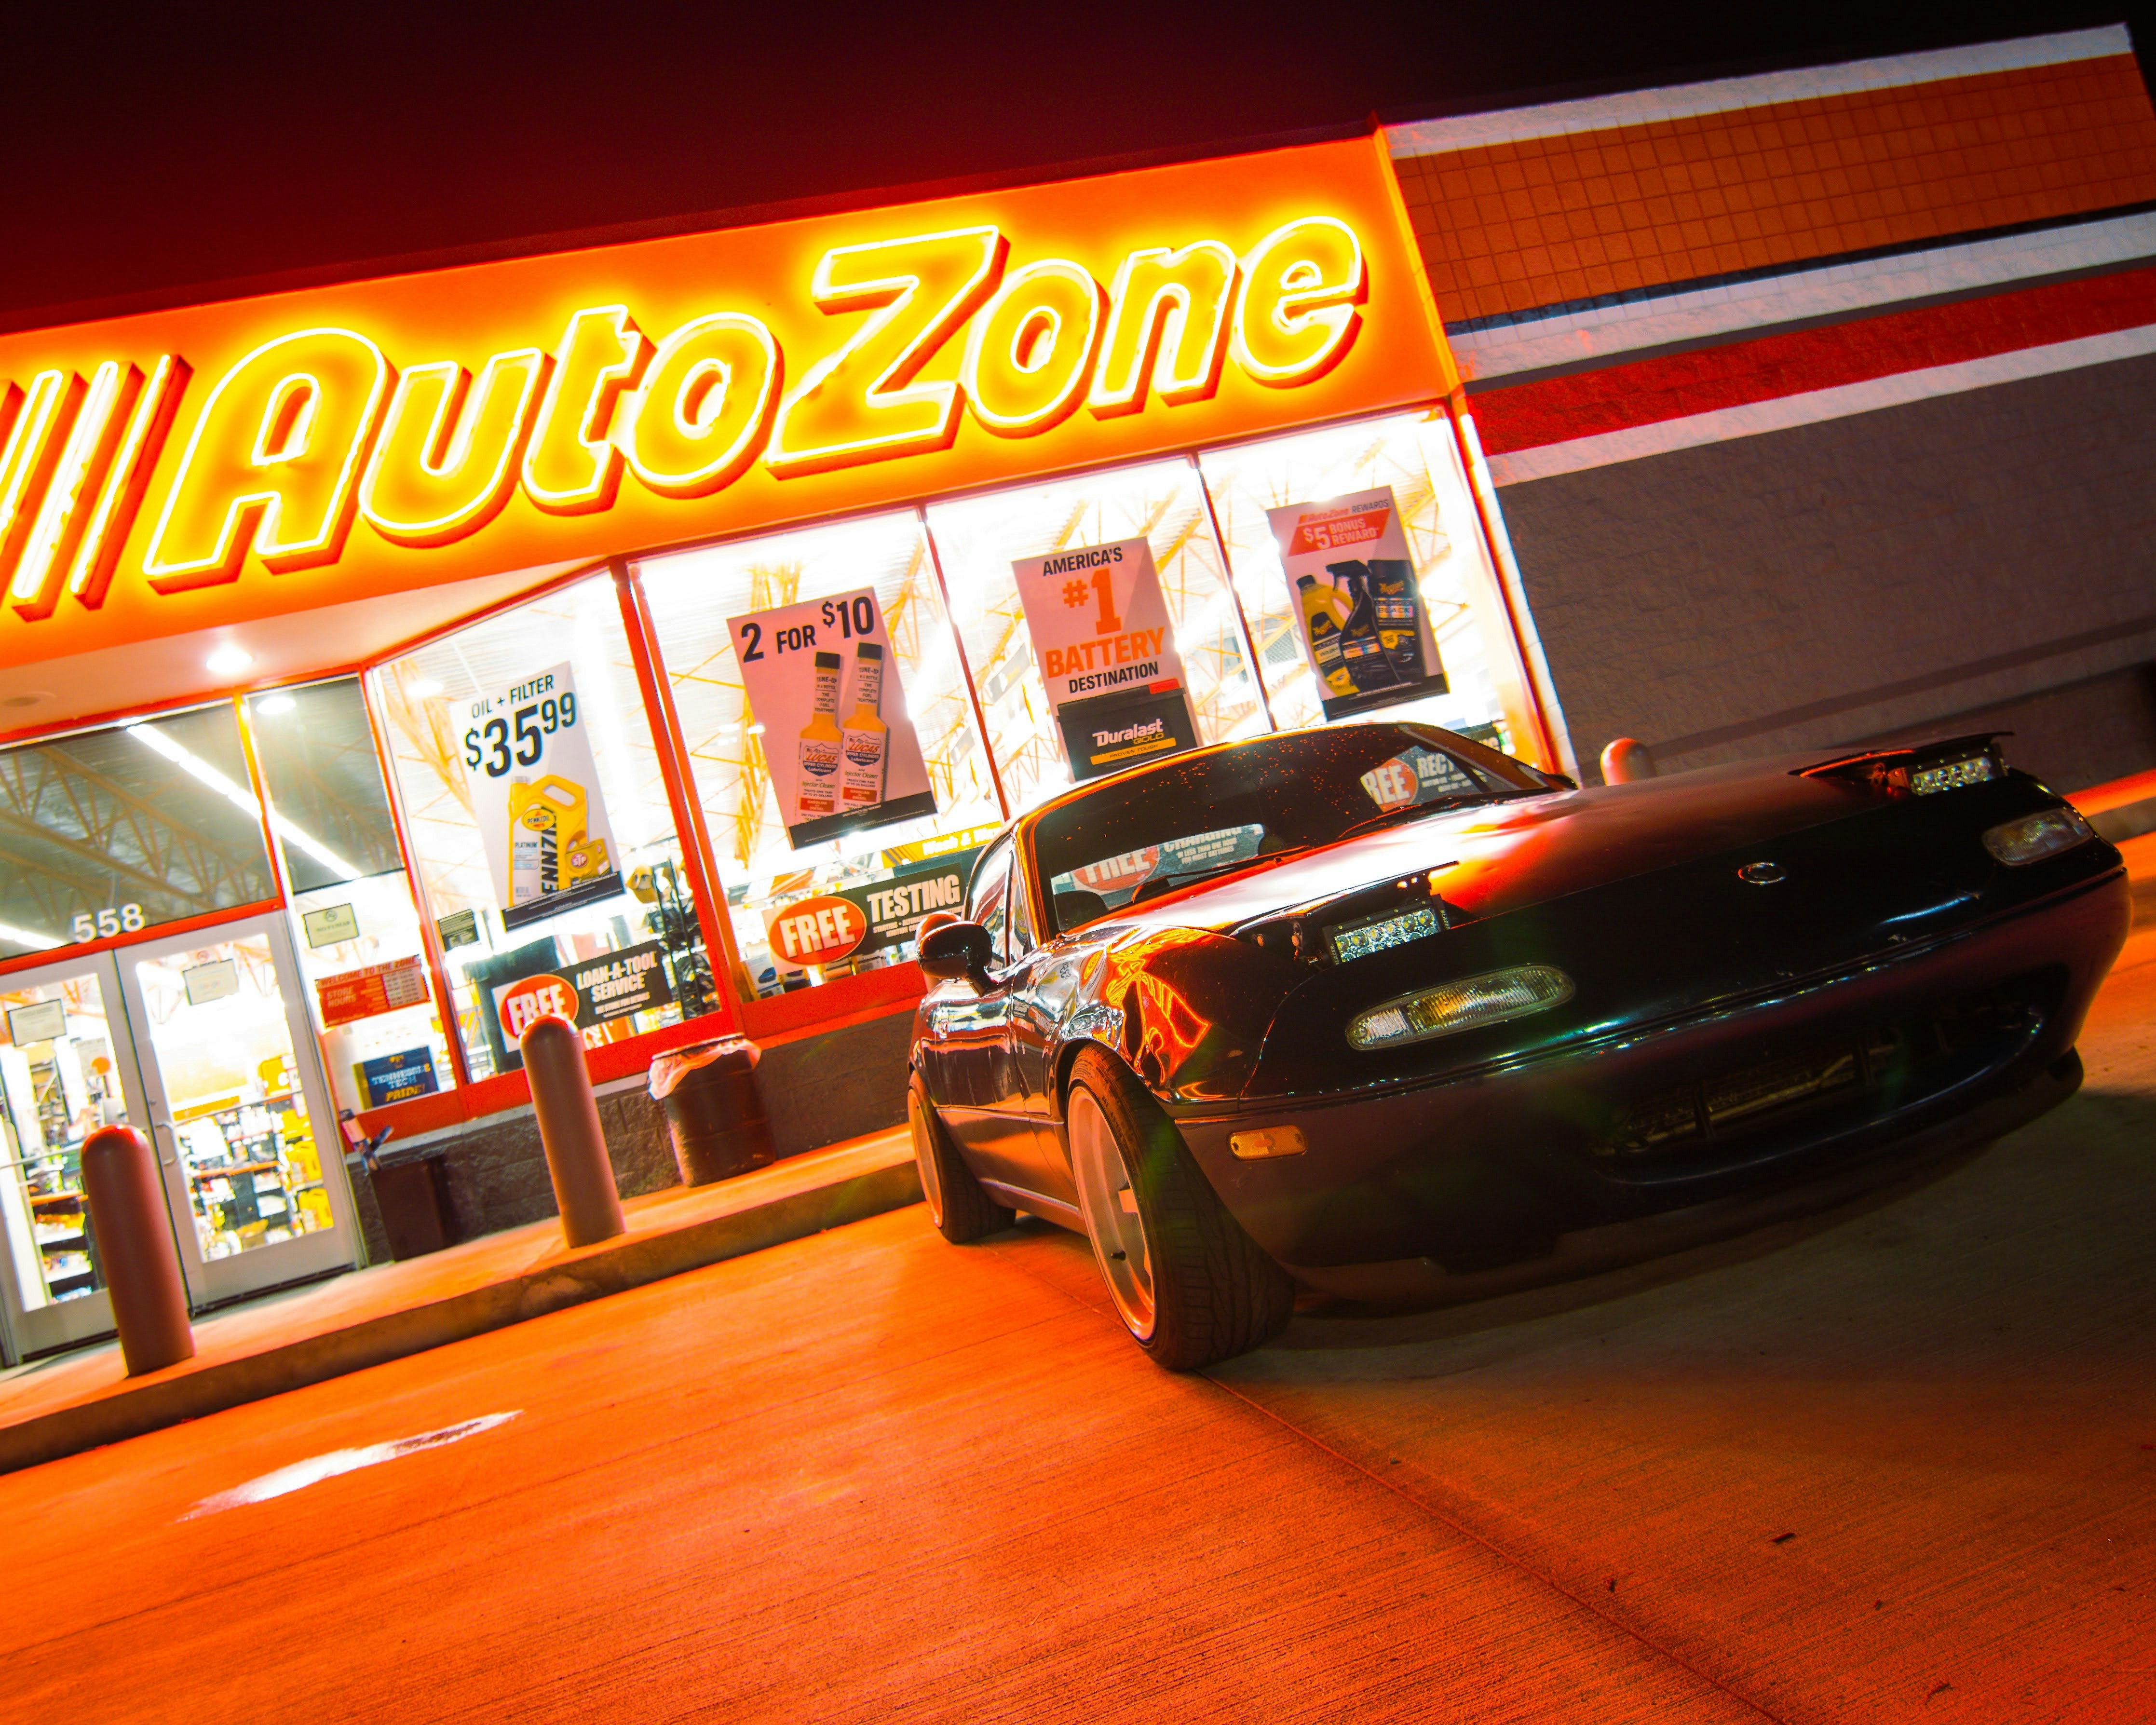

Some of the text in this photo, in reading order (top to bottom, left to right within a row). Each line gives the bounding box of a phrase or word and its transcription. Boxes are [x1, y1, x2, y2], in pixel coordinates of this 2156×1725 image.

[144, 215, 1366, 593] AutoZone
[1352, 499, 1389, 513] REWARDS
[1329, 517, 1366, 534] BONUS
[1331, 528, 1377, 545] REWARD
[1303, 527, 1330, 550] $5
[1043, 547, 1123, 576] AMERICA'S
[1062, 568, 1122, 635] #1
[741, 597, 875, 663] 2 FOR $10
[1045, 627, 1165, 679] BATTERY
[1069, 661, 1159, 693] DESTINATION
[472, 702, 492, 719] OIL
[509, 675, 554, 705] FILTER
[1092, 718, 1163, 747] Duralast
[1133, 733, 1165, 745] GOLD
[805, 753, 838, 763] LUCAS
[848, 743, 880, 753] LUCAS
[1110, 744, 1158, 759] PROVEN TOUGH
[572, 853, 587, 868] STP
[1181, 845, 1234, 865] FOR MOST BATTERIES
[1184, 847, 1197, 857] LESS
[1197, 844, 1211, 854] THAN
[1211, 841, 1222, 850] ONE
[867, 874, 961, 923] TESTING
[73, 903, 145, 943] 558
[779, 905, 856, 958] FREE
[873, 921, 898, 934] STARTERS
[886, 926, 909, 938] IGNITION
[322, 969, 361, 986] WELCOME
[378, 964, 392, 972] THE
[394, 958, 417, 969] ZONE
[576, 951, 658, 990] LOAN-A-TOOL
[327, 986, 355, 1000] STORE
[591, 972, 645, 1003] SERVICE
